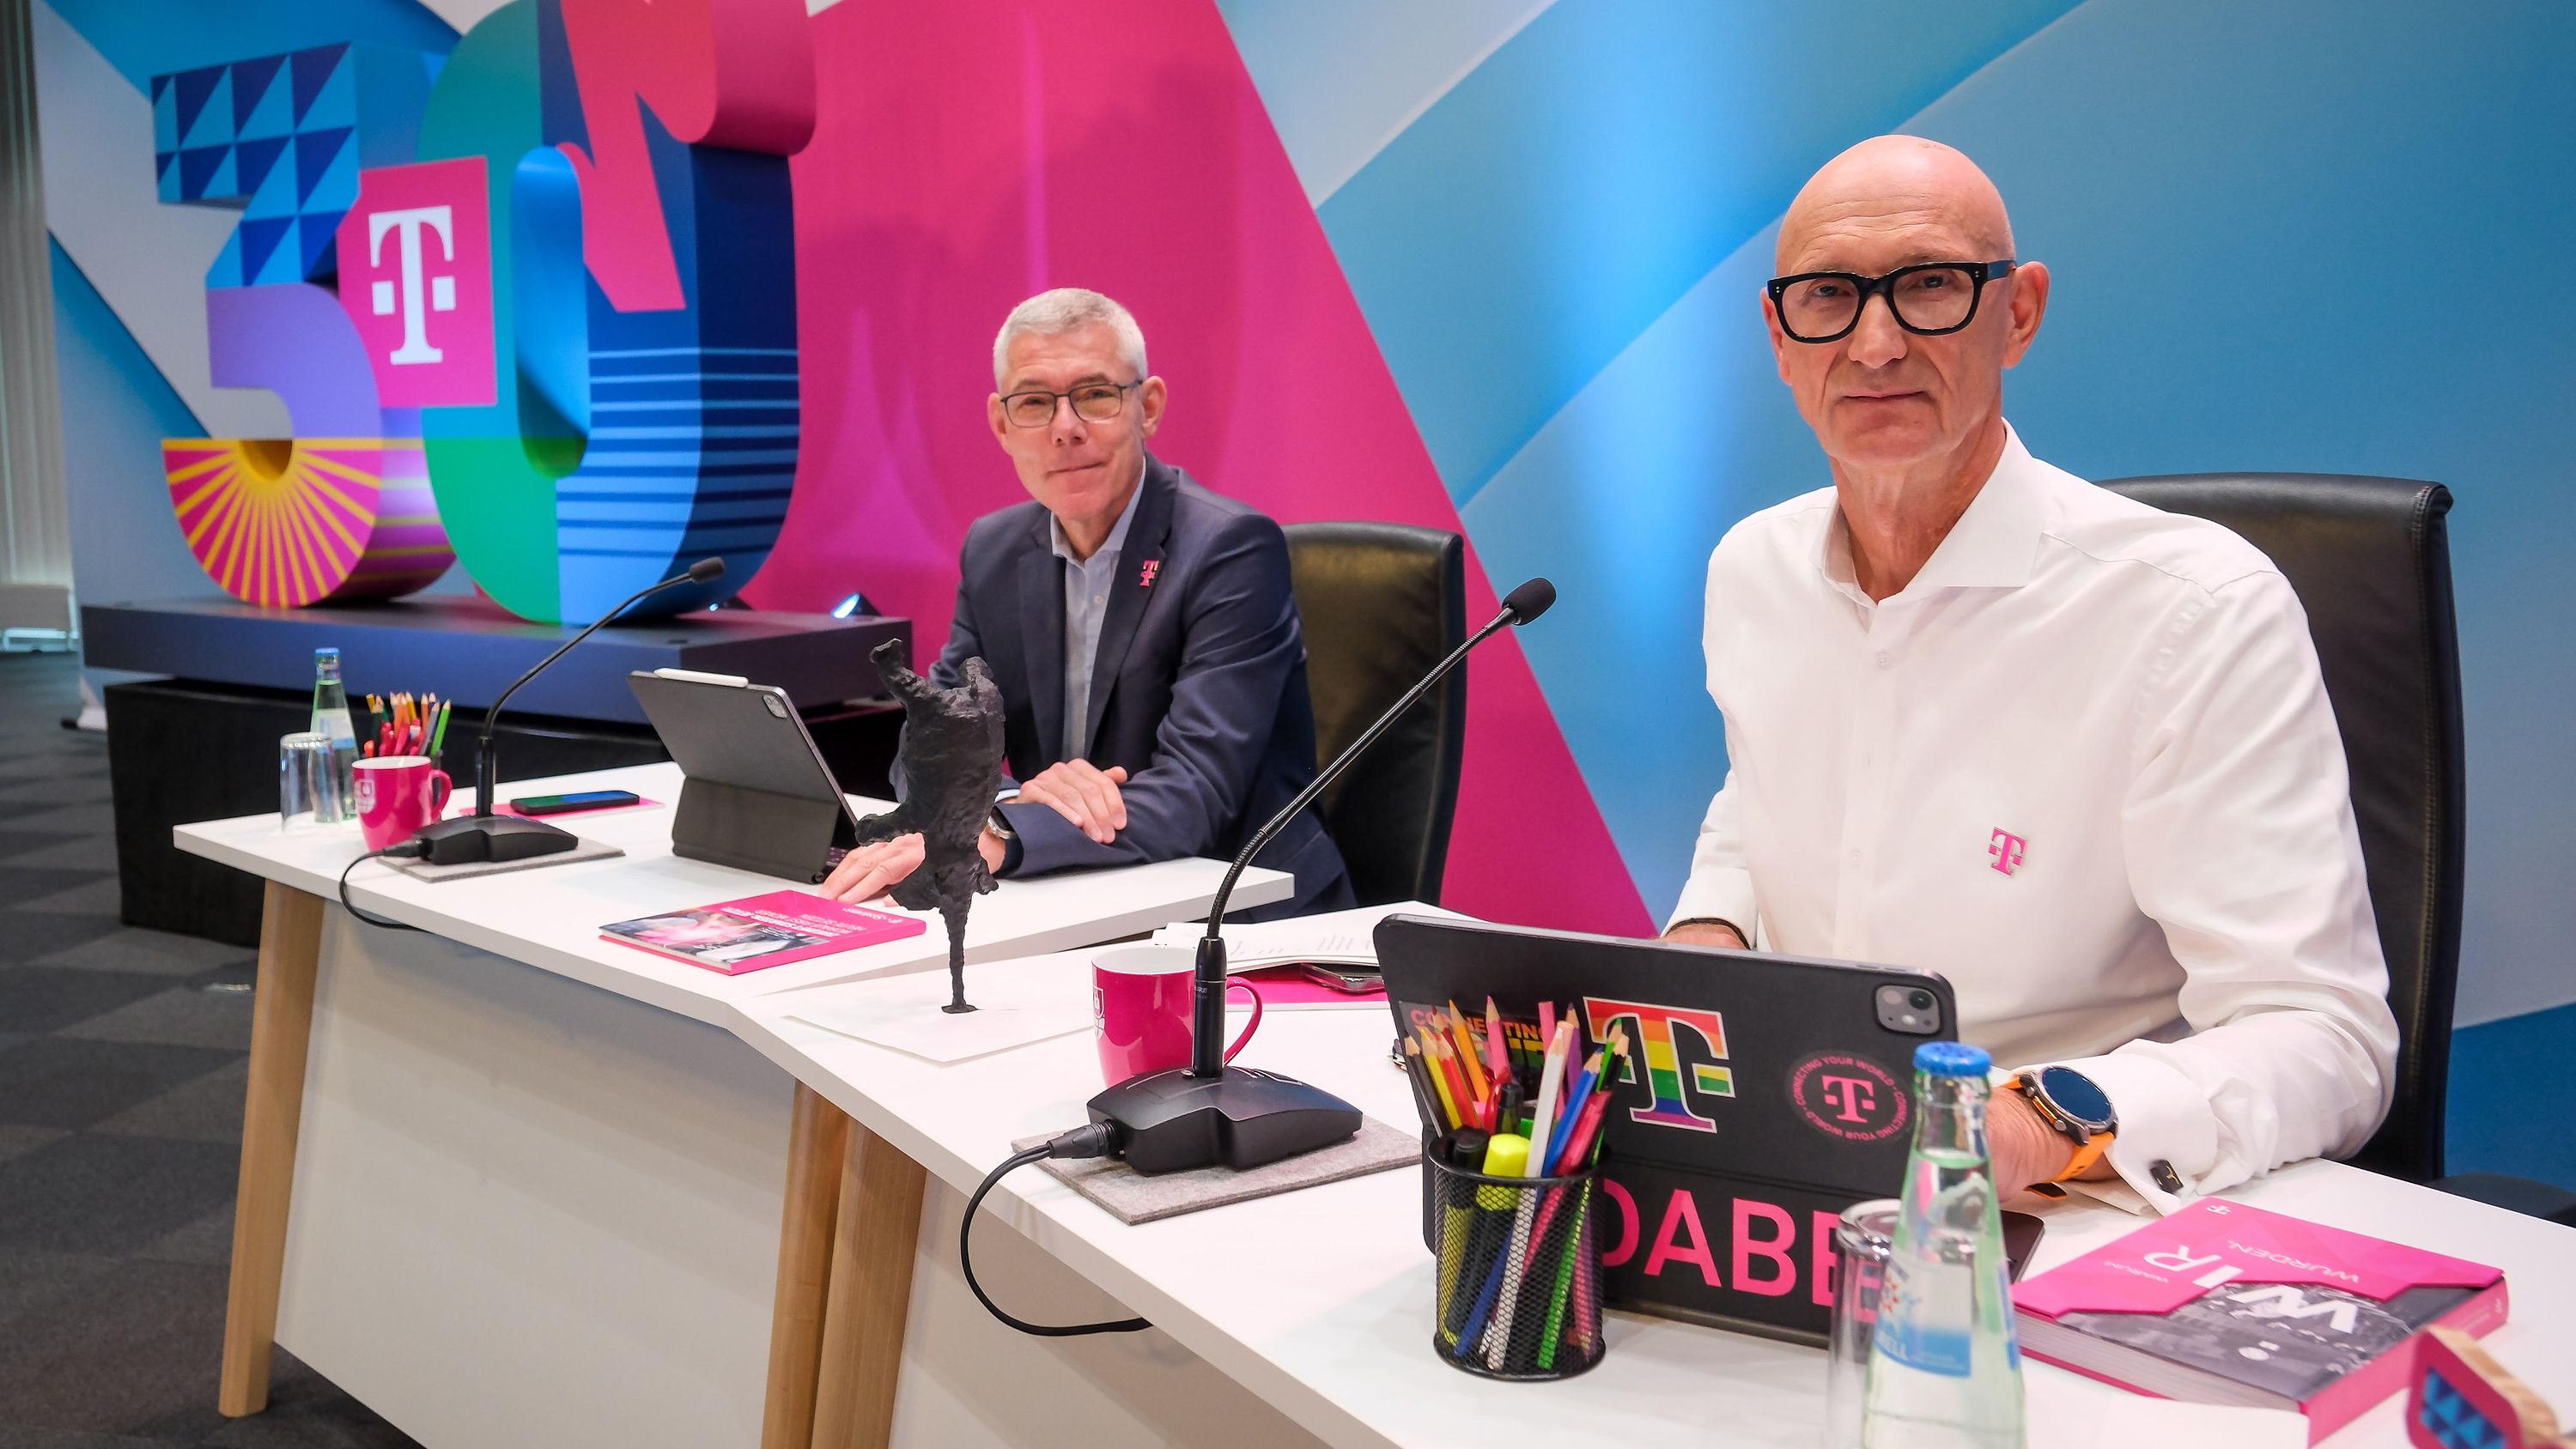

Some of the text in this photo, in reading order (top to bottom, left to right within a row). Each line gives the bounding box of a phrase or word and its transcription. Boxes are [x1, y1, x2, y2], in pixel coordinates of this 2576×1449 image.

[368, 205, 456, 365] T
[1989, 827, 2026, 876] T
[1583, 996, 1735, 1133] T
[1821, 1056, 1854, 1065] YOUR
[1821, 1075, 1875, 1124] T
